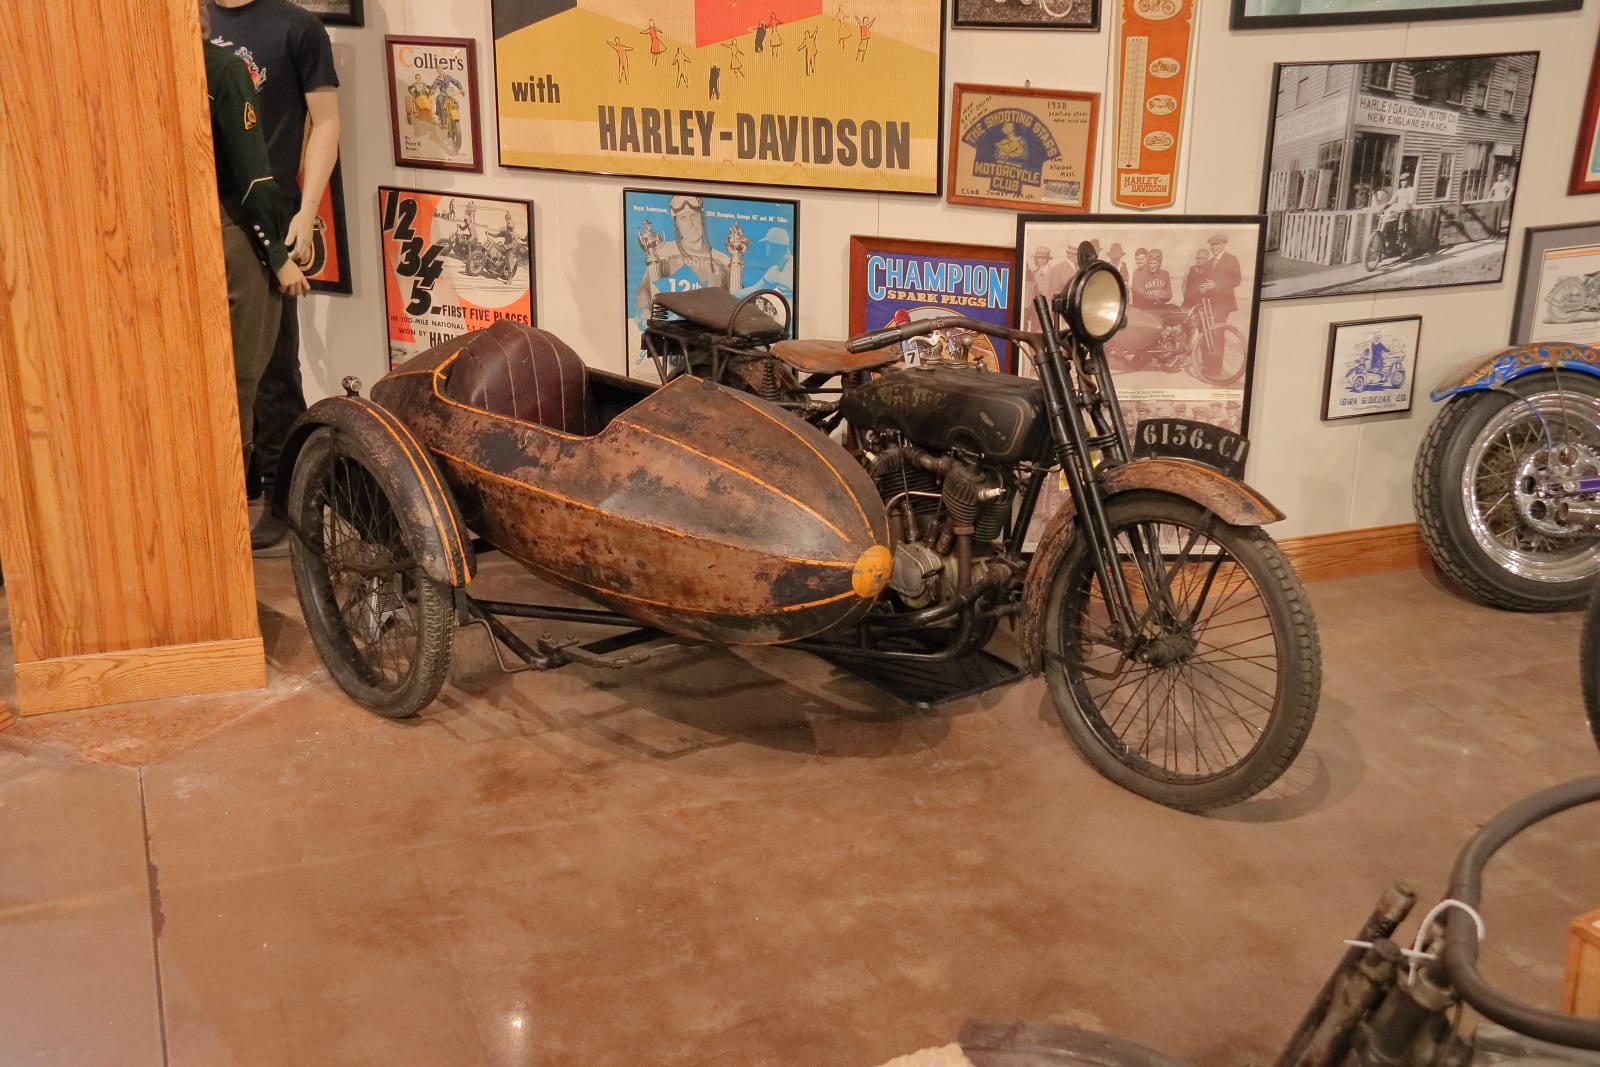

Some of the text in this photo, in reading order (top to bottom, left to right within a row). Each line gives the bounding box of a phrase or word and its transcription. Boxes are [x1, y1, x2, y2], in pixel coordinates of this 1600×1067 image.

[399, 46, 464, 71] Collier's
[511, 74, 561, 103] with
[1367, 112, 1386, 124] NEW
[598, 105, 910, 170] HARLEY-DAVIDSON
[965, 110, 1058, 157] THE SHOOTING STARS
[974, 161, 1041, 184] MOTORCYCLE
[1124, 176, 1163, 187] HARLEY-
[992, 176, 1020, 192] CLUB
[384, 191, 400, 231] 1
[393, 198, 417, 240] 2
[396, 236, 424, 277] 3
[414, 244, 444, 288] 4
[887, 290, 988, 308] SPARK PLUGS
[401, 316, 429, 326] 100-MILE
[431, 320, 464, 330] NATIONAL
[442, 304, 467, 319] FIRST
[470, 308, 490, 322] FIVE
[398, 327, 416, 335] WON
[906, 351, 916, 364] 7
[1339, 397, 1357, 406] IOWA
[1361, 395, 1391, 404] SIDECAR
